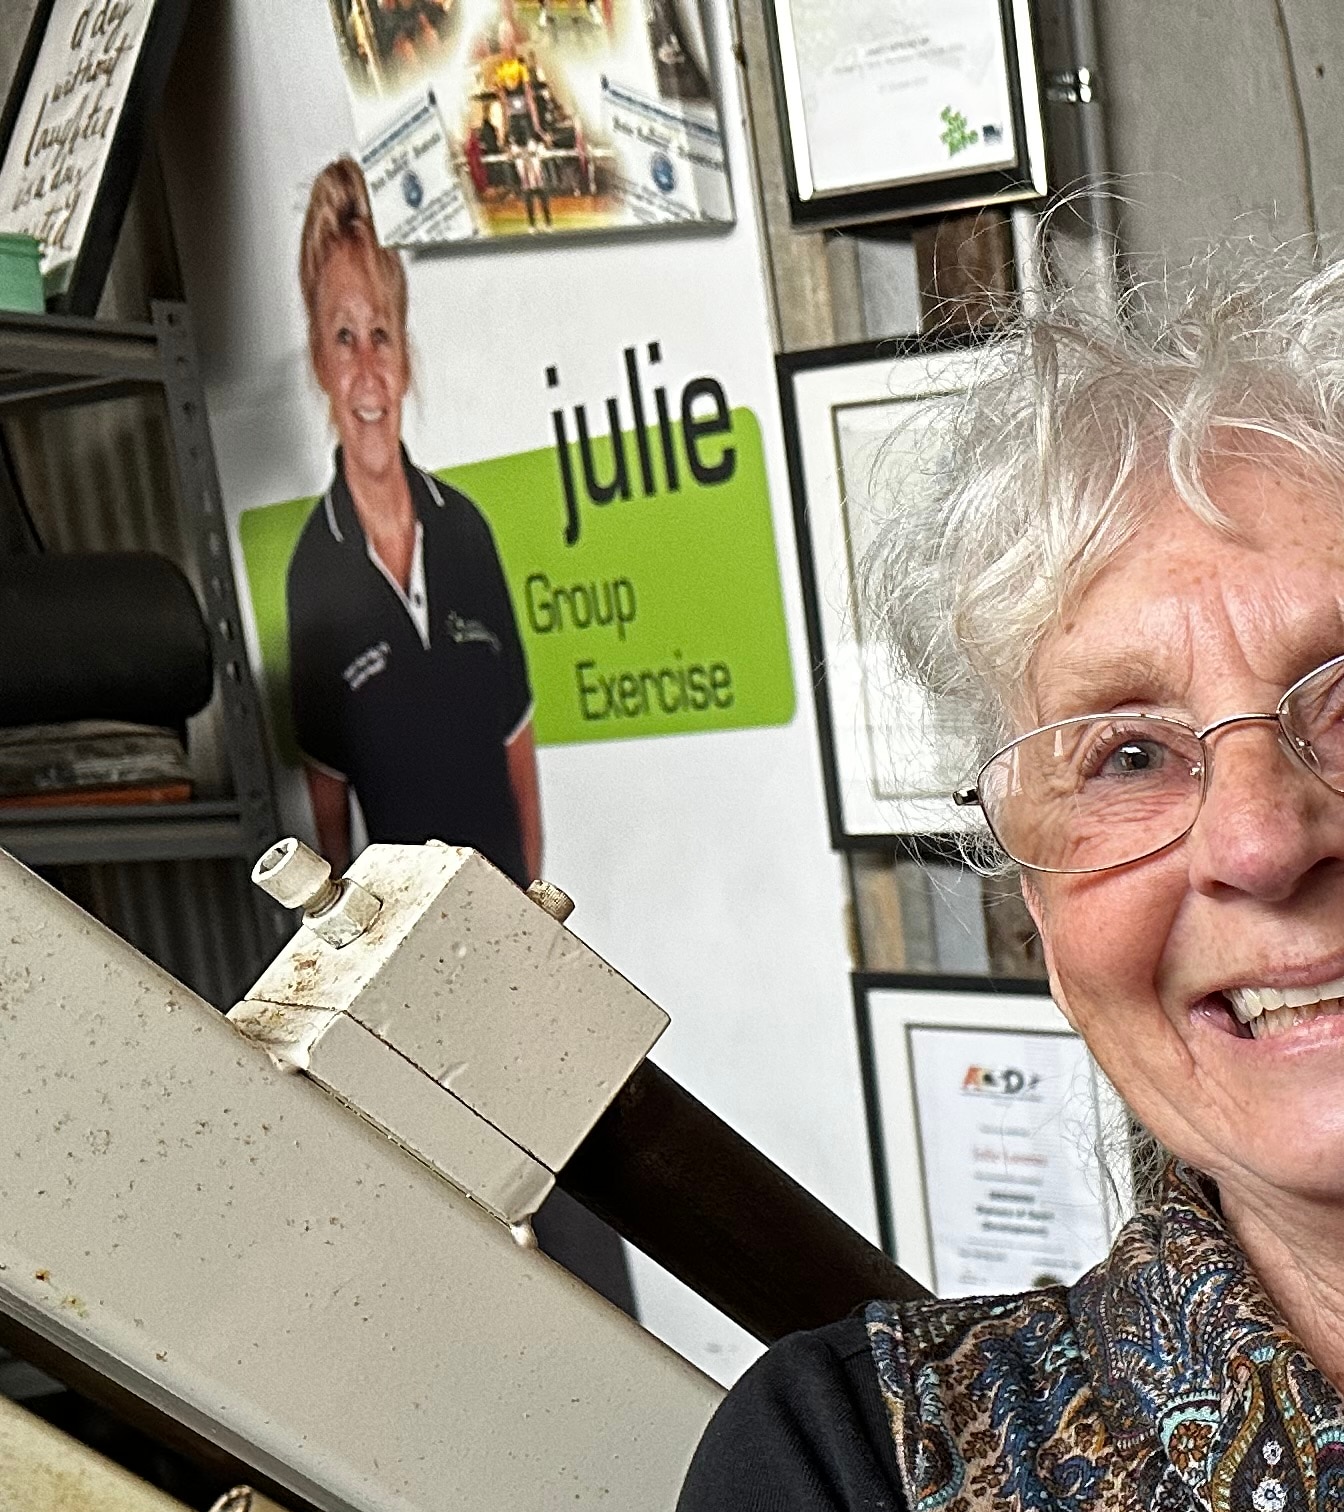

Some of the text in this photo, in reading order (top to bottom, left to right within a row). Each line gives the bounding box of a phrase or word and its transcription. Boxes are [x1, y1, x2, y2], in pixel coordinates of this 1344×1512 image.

[546, 341, 737, 547] julie
[523, 570, 638, 641] Group
[575, 649, 735, 722] Exercise
